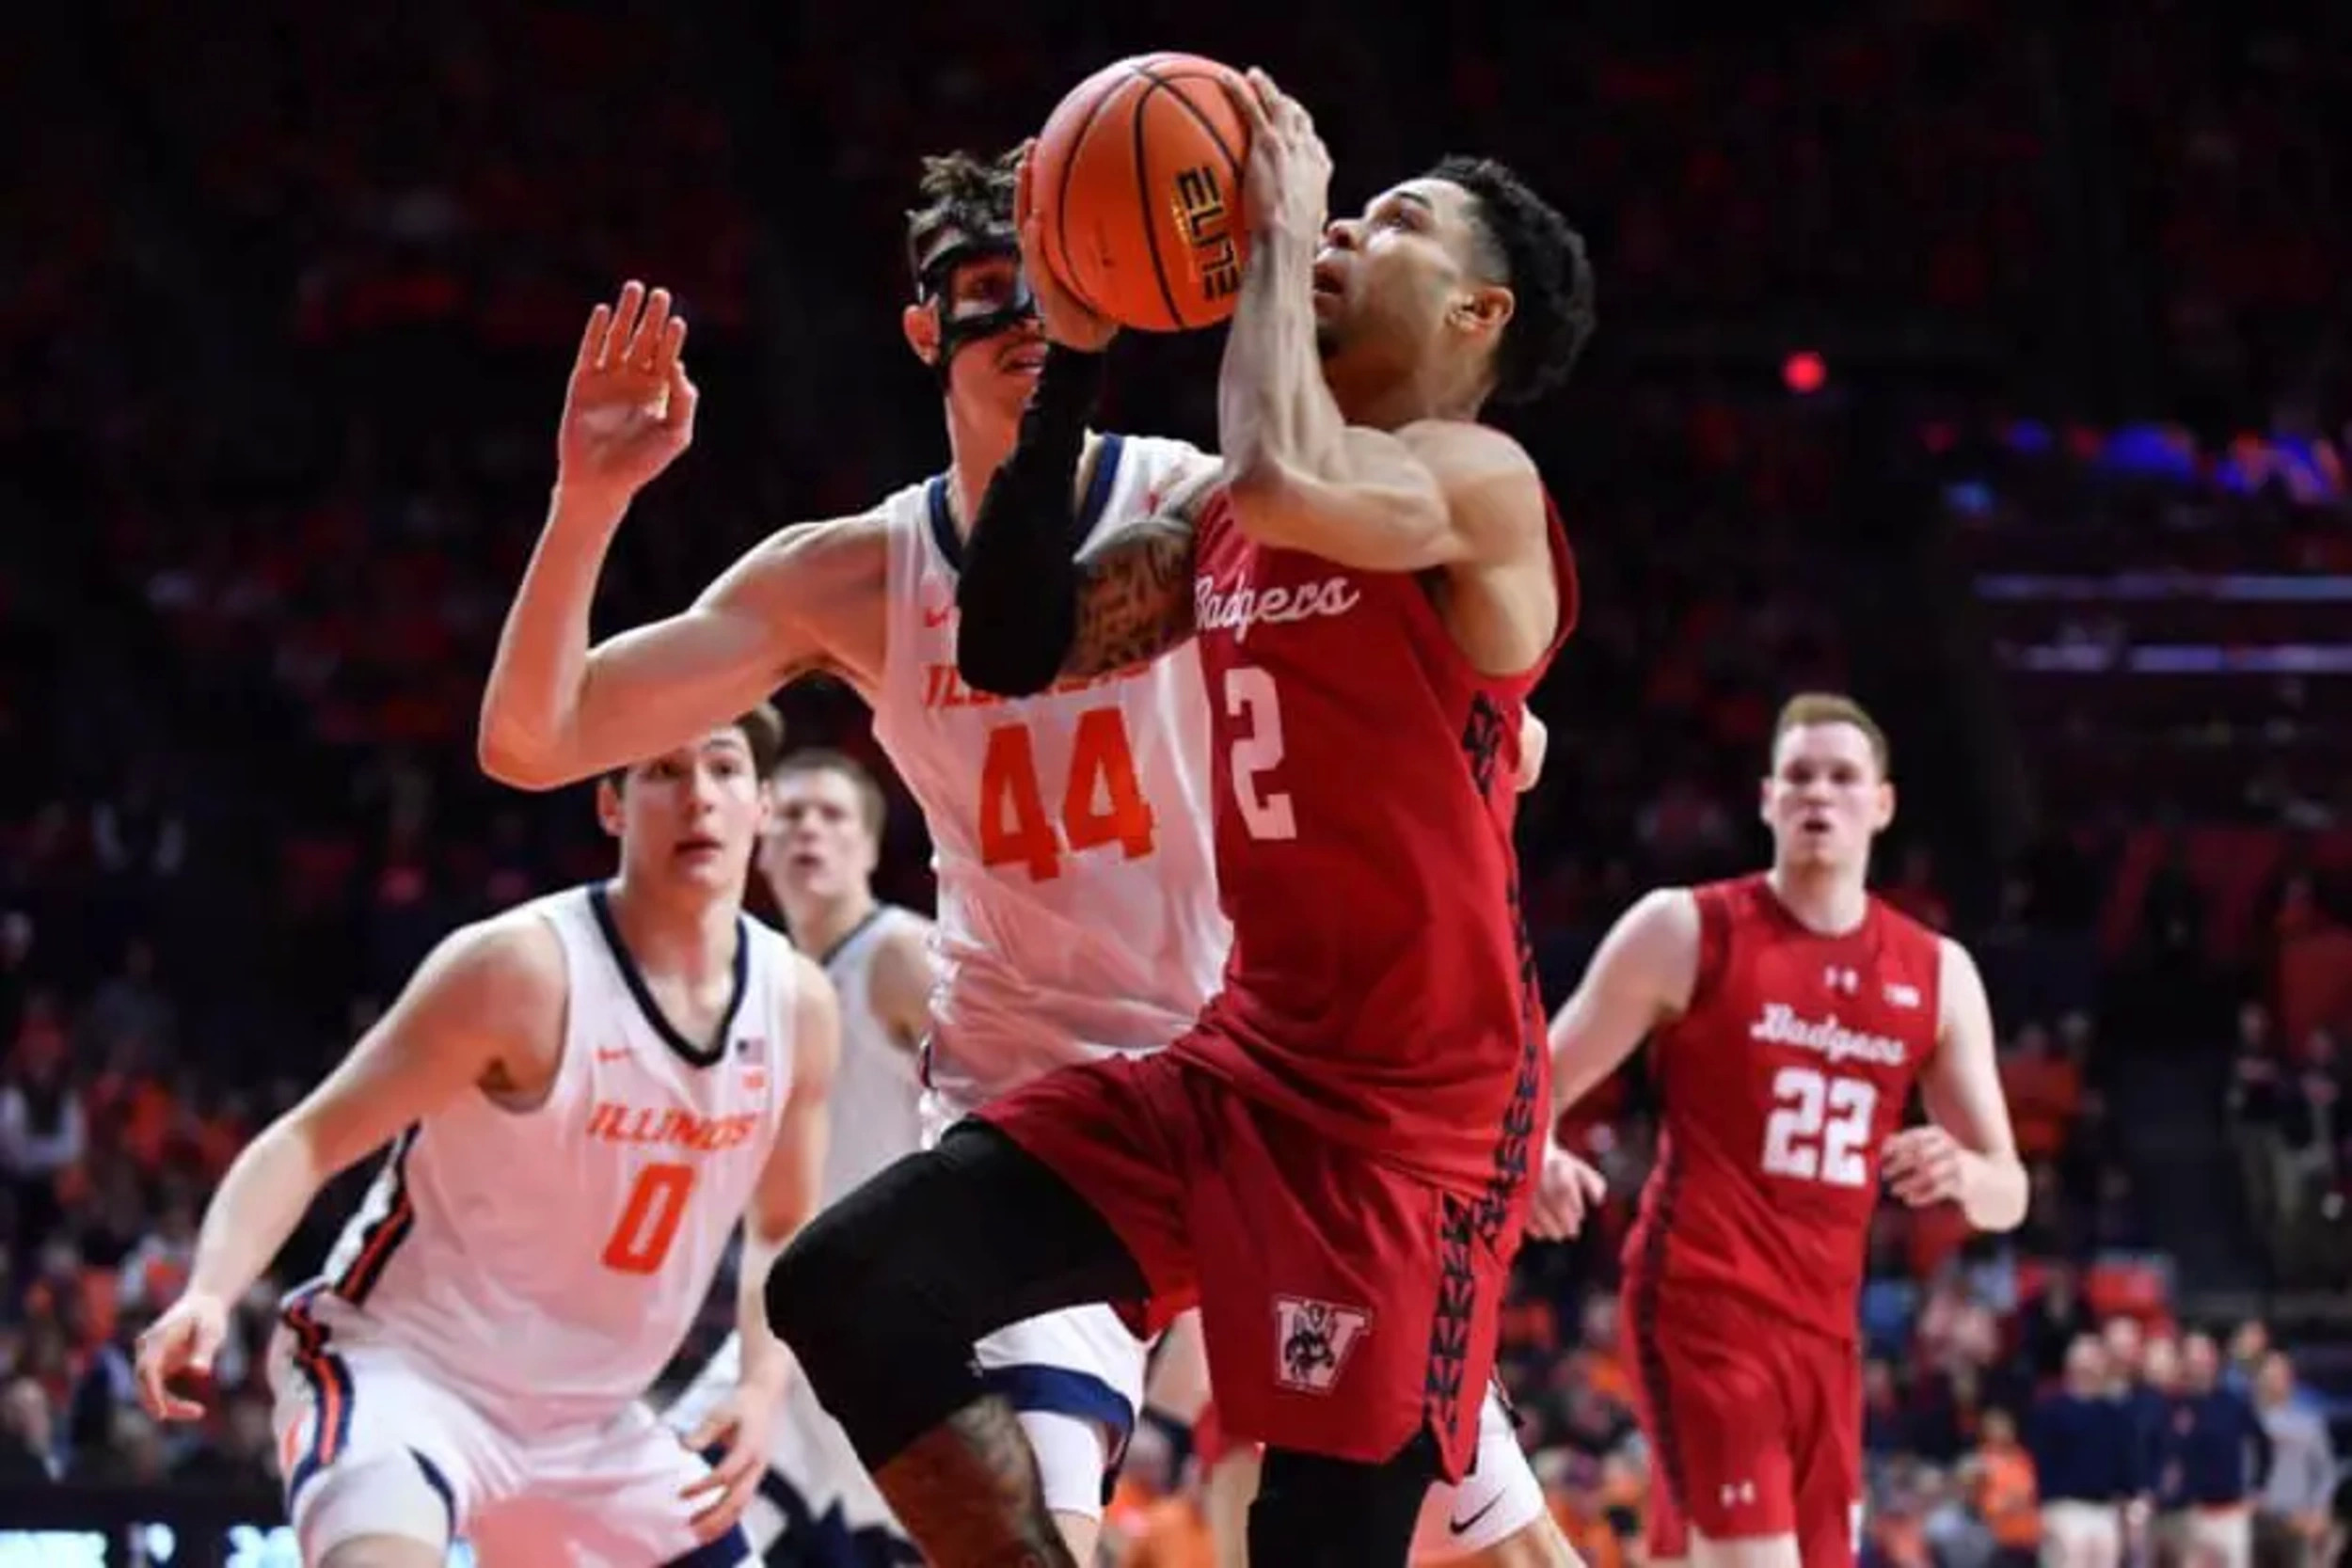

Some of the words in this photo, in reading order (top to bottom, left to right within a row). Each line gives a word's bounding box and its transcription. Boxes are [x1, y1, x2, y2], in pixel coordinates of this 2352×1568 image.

[1176, 166, 1241, 301] ELITE
[1194, 570, 1360, 643] Badgers
[979, 706, 1153, 882] 44
[1225, 666, 1297, 840] 2
[1750, 1002, 1904, 1066] Badgers
[1762, 1066, 1877, 1187] 22
[600, 1164, 695, 1275] 0
